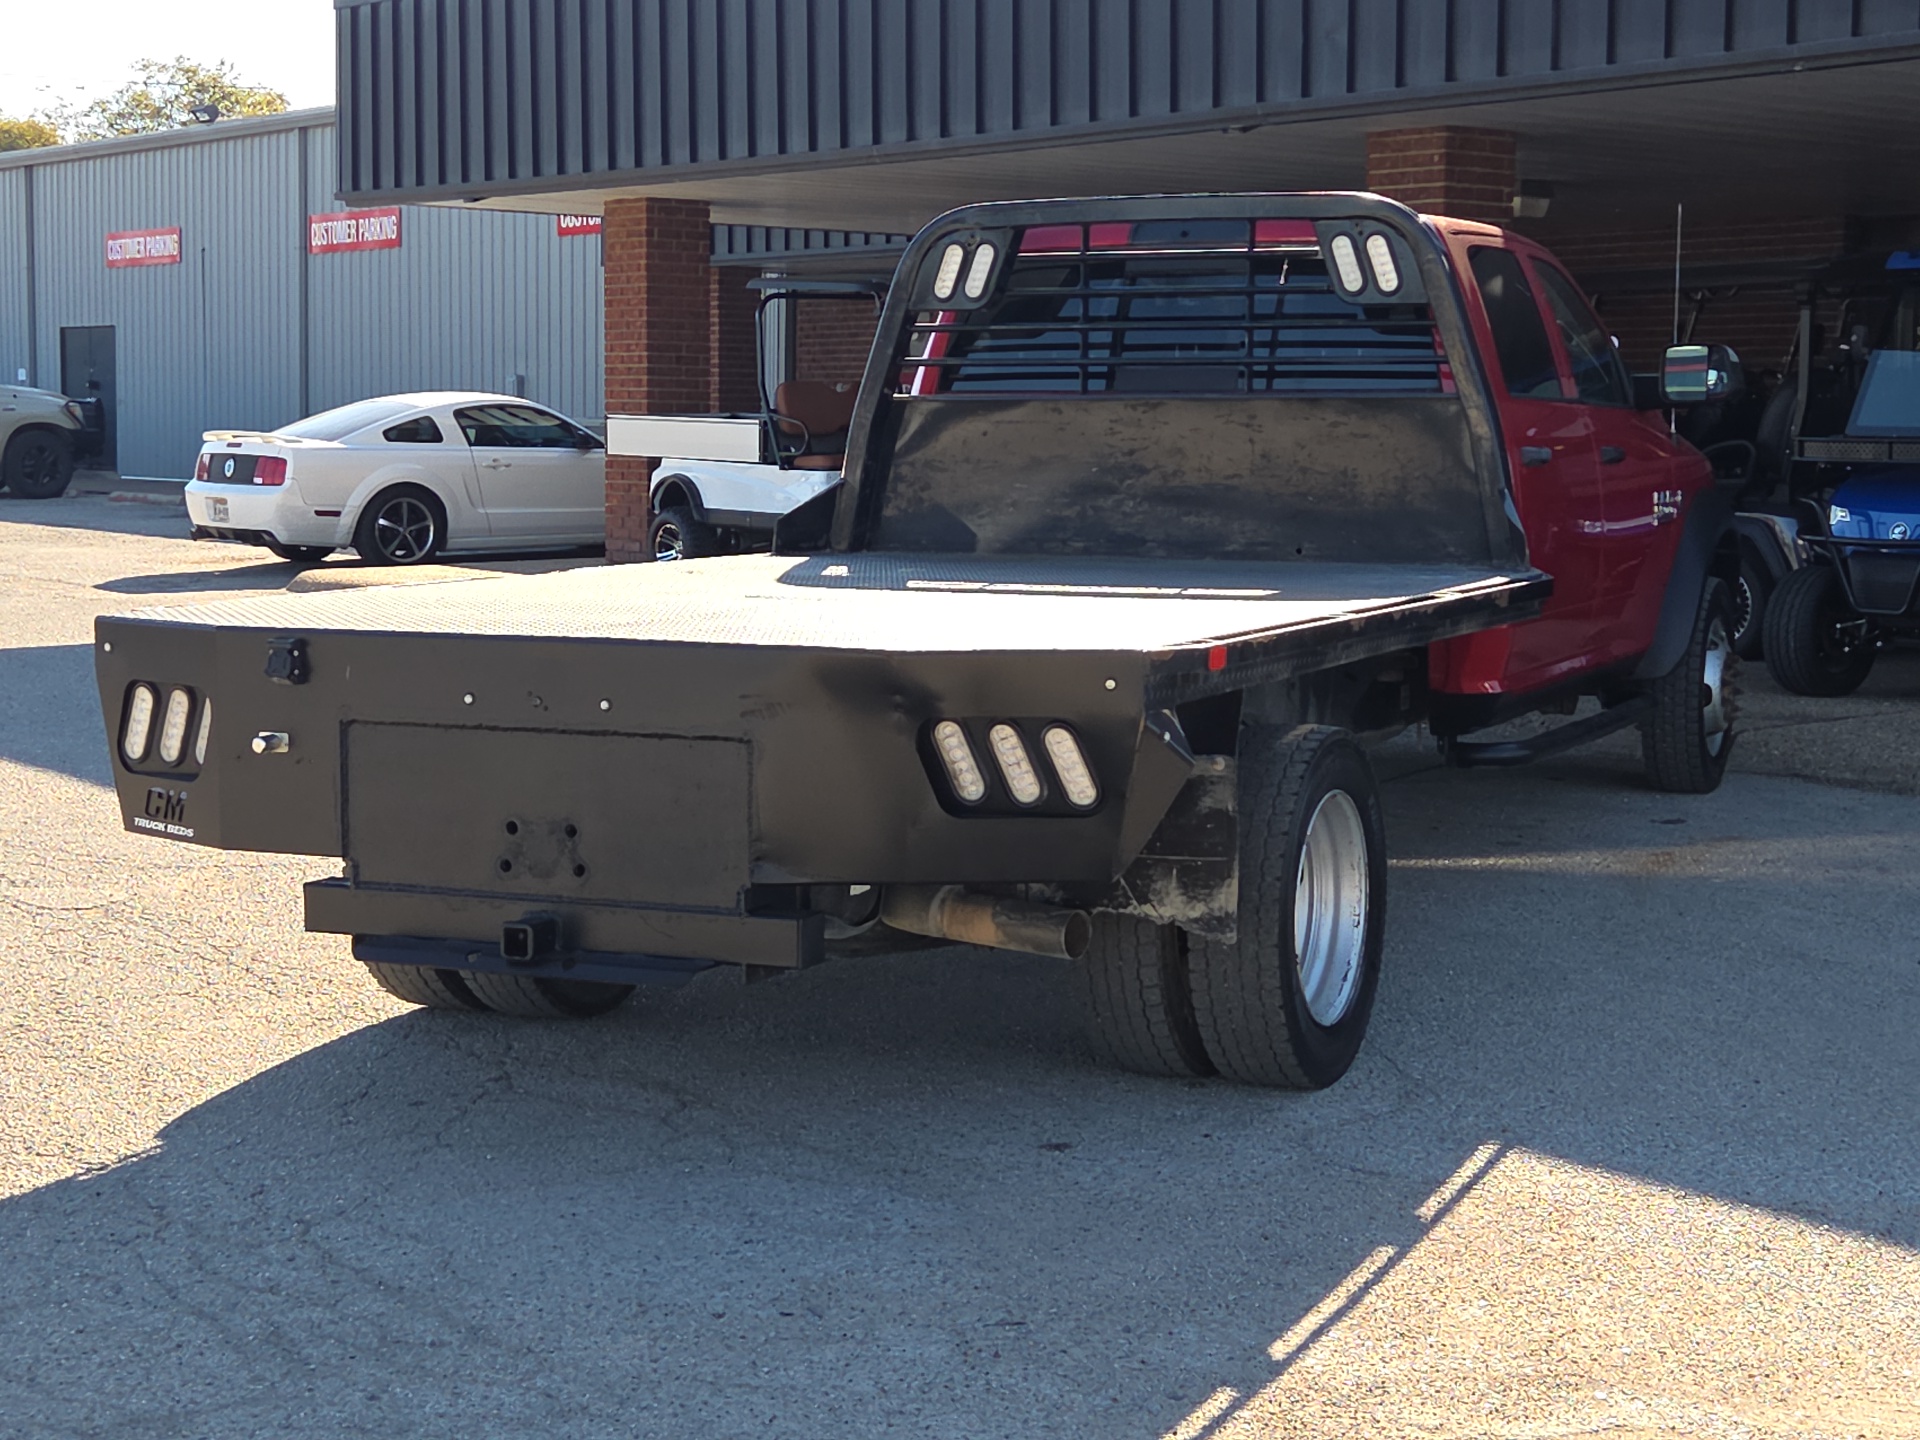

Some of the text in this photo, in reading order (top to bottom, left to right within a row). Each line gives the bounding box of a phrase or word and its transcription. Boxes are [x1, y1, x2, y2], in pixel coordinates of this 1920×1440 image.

[311, 215, 397, 246] CUSTOMER PARKING
[108, 234, 178, 260] CUSTOMER PARKING
[145, 787, 188, 822] CM
[133, 817, 195, 837] TRUCK BEDS
